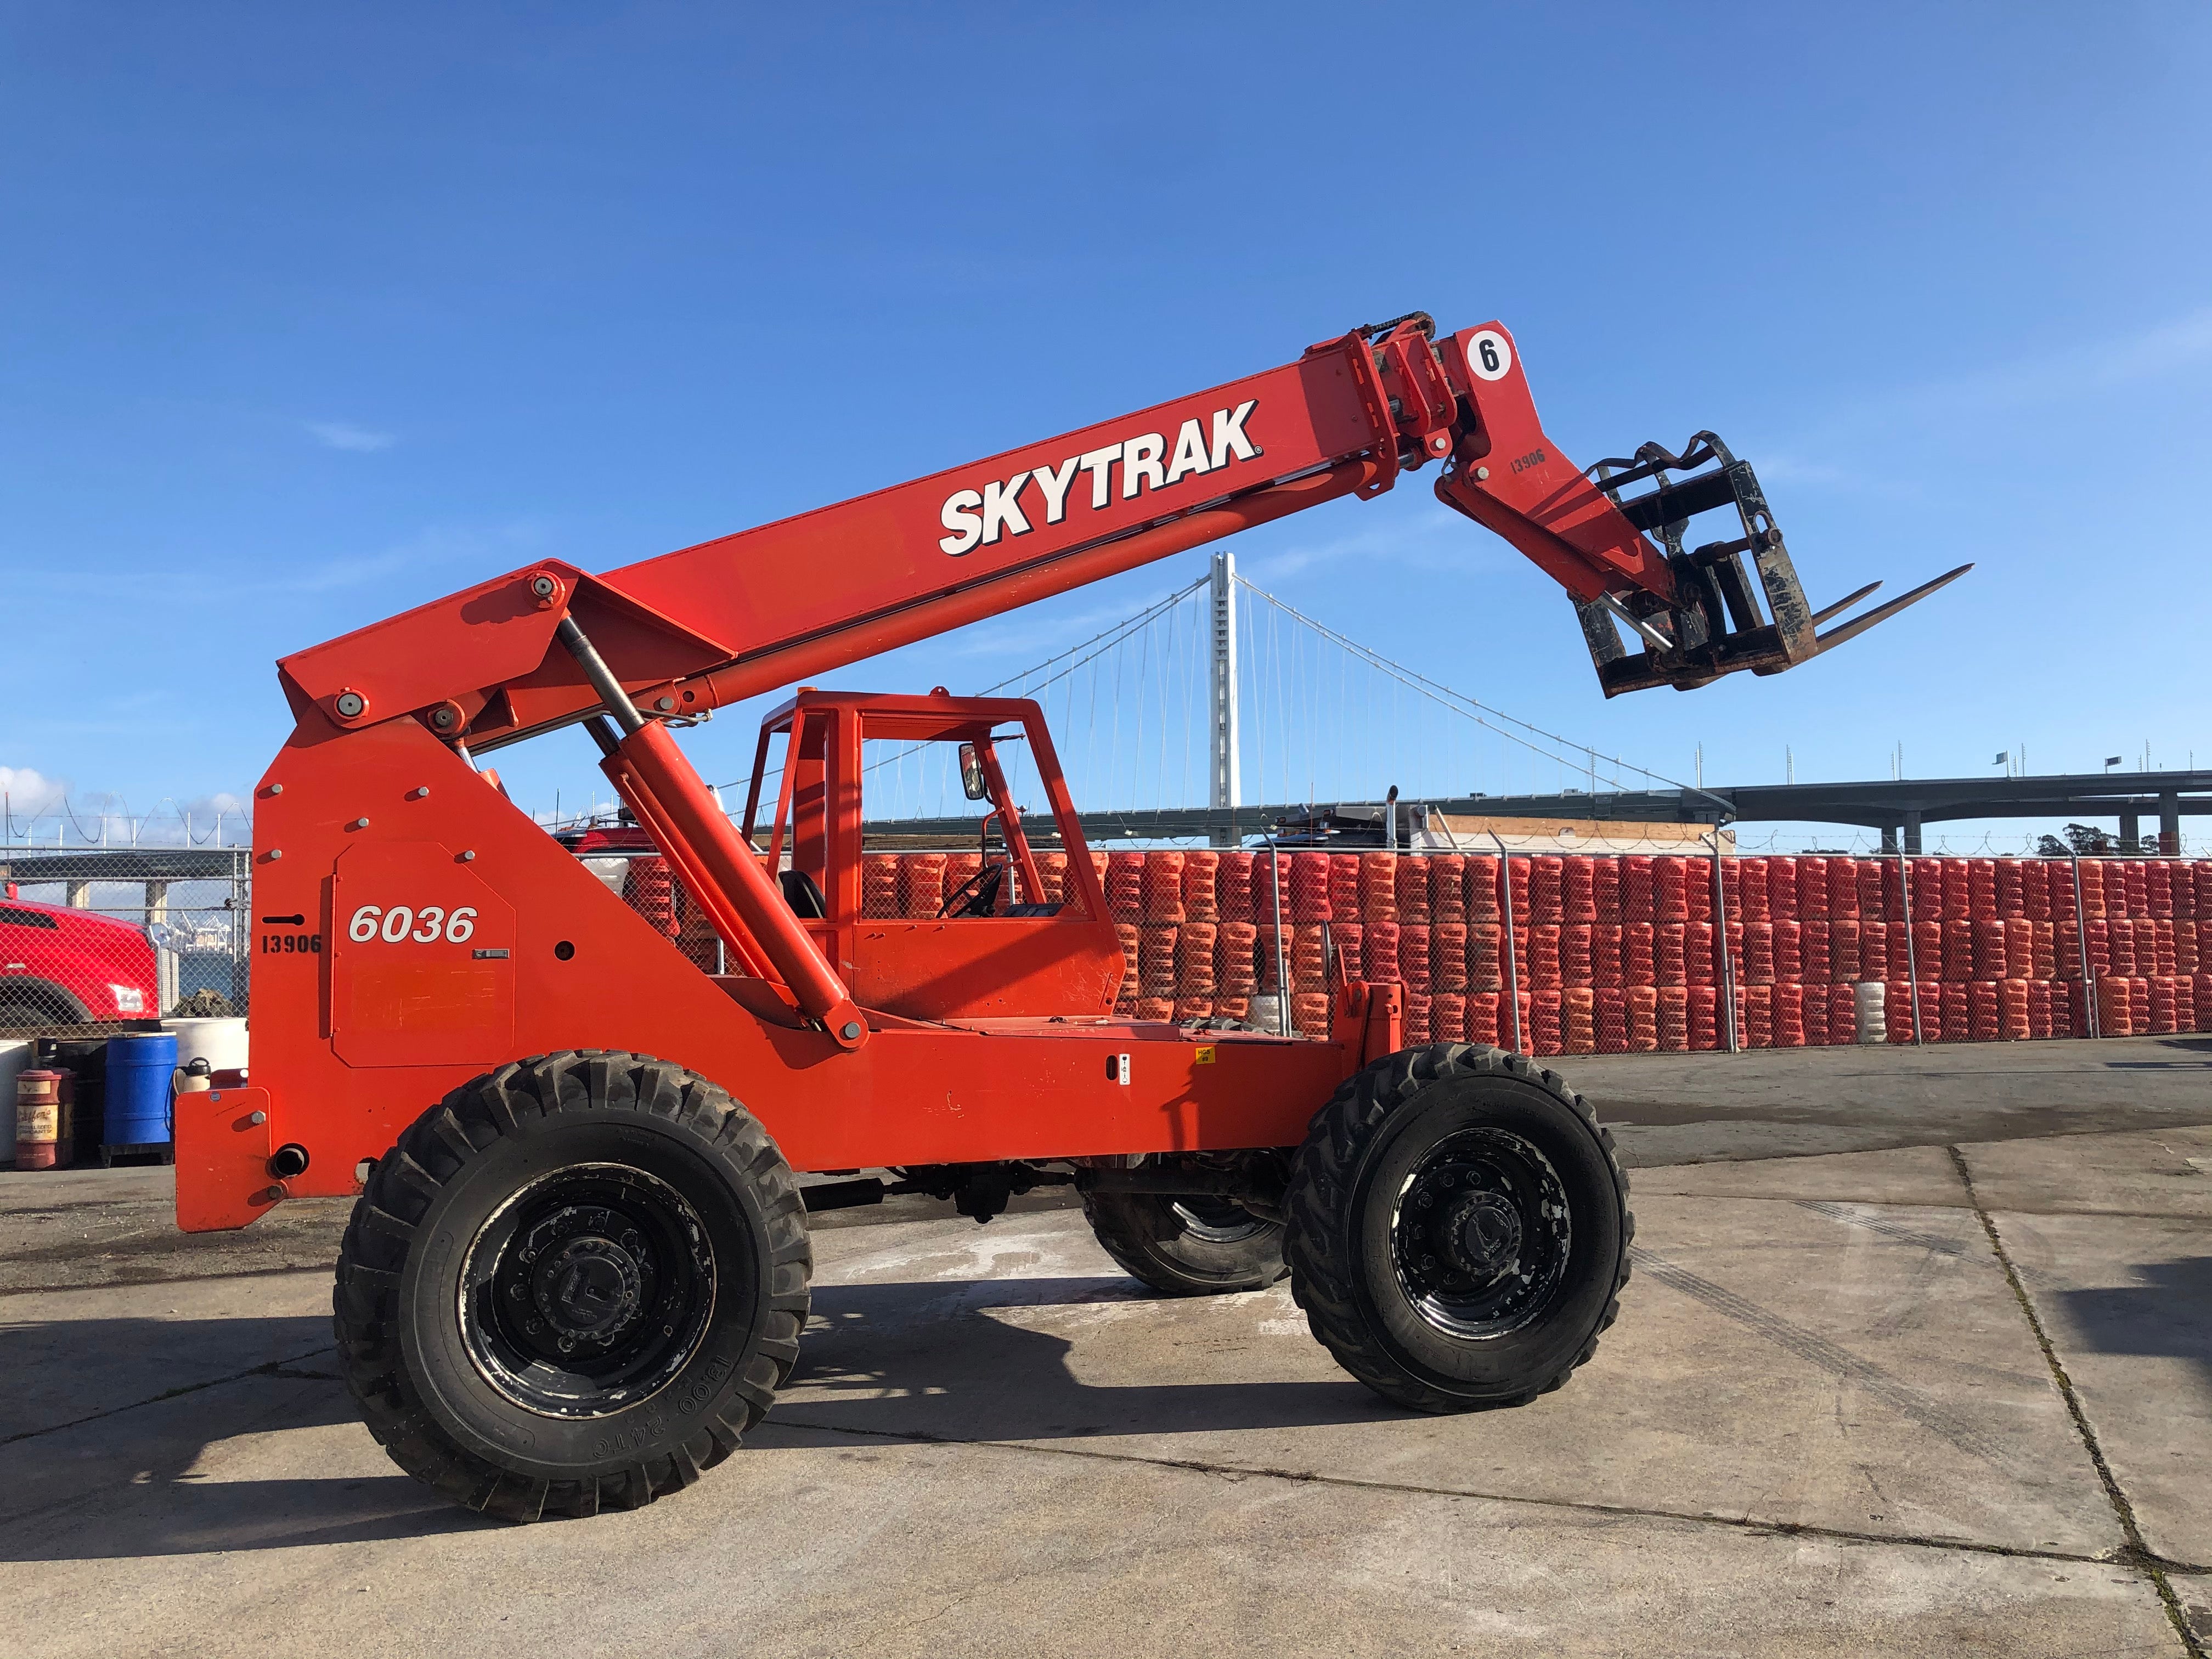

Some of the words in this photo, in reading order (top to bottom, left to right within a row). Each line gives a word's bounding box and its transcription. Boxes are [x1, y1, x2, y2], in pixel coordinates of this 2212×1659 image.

[1479, 339, 1500, 371] 6
[1510, 448, 1545, 474] 13906
[348, 905, 478, 944] 6036
[262, 934, 322, 954] 13906
